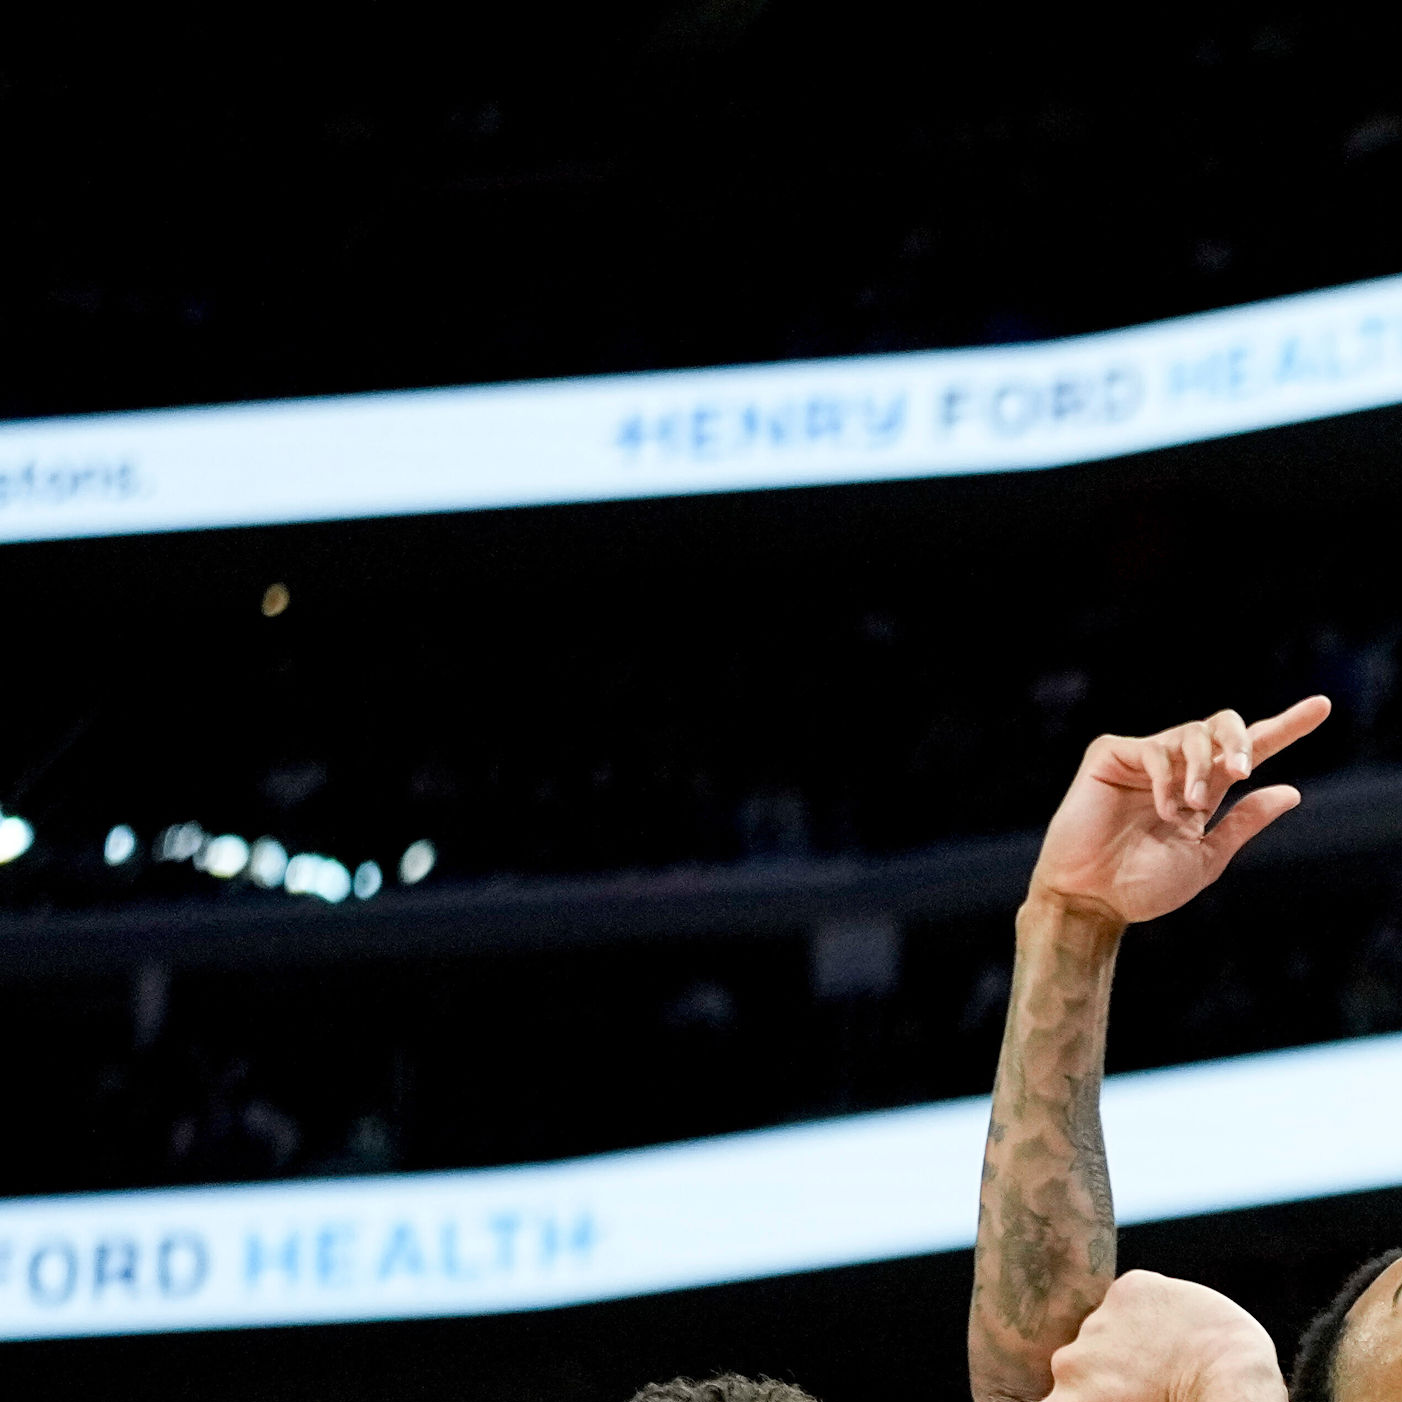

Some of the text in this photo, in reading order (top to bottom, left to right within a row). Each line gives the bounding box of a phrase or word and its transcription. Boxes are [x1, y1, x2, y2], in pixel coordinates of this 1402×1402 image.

[612, 384, 906, 464] HENRY
[941, 364, 1144, 442] FORD
[0, 1206, 598, 1306] ORD HEALTH
